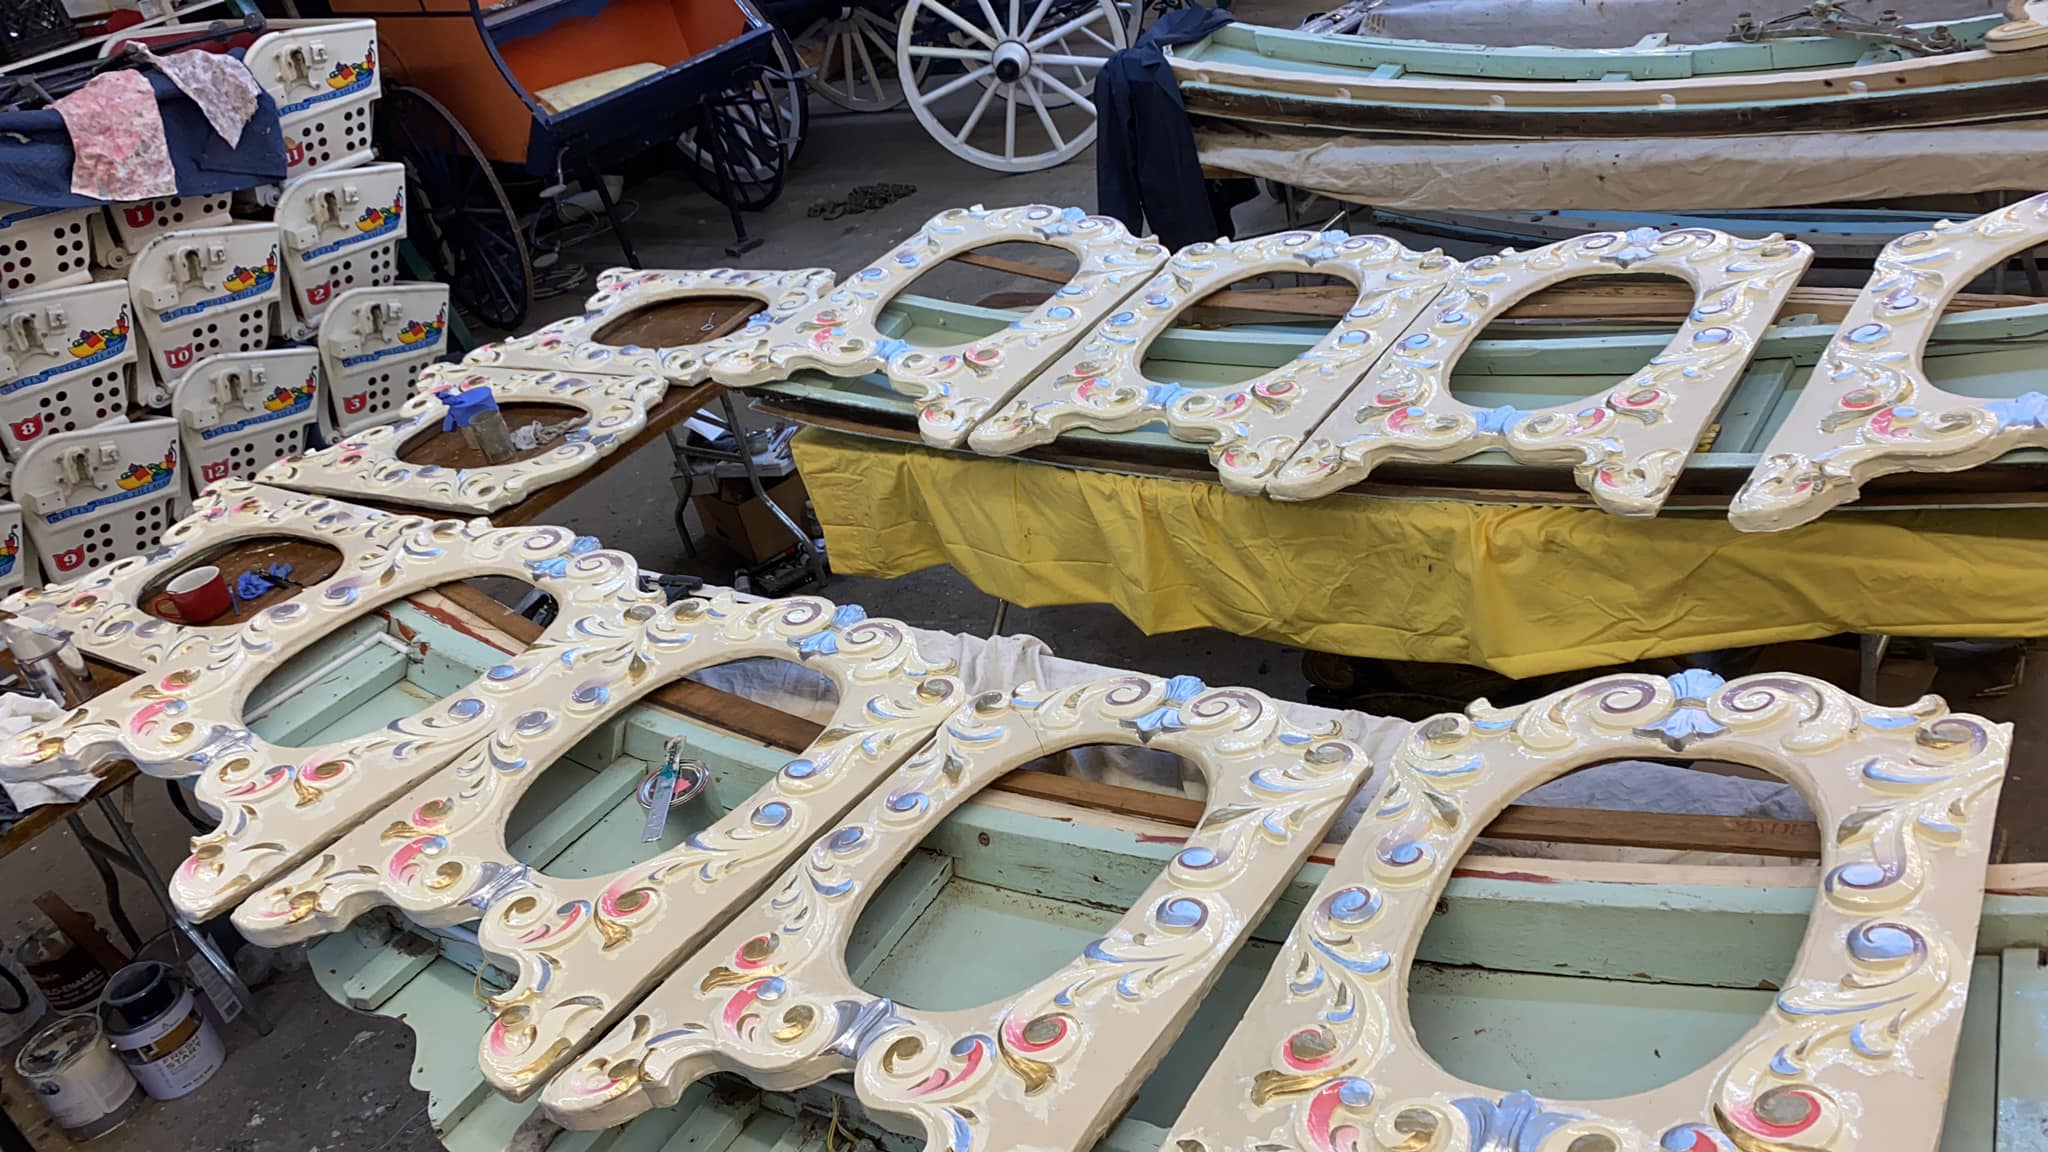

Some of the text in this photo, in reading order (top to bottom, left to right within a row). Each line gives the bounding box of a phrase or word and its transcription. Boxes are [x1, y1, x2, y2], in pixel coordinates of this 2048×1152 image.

[313, 287, 326, 300] 2
[169, 349, 190, 365] 10
[21, 422, 36, 435] 8
[207, 465, 225, 479] 12
[63, 553, 78, 566] 9
